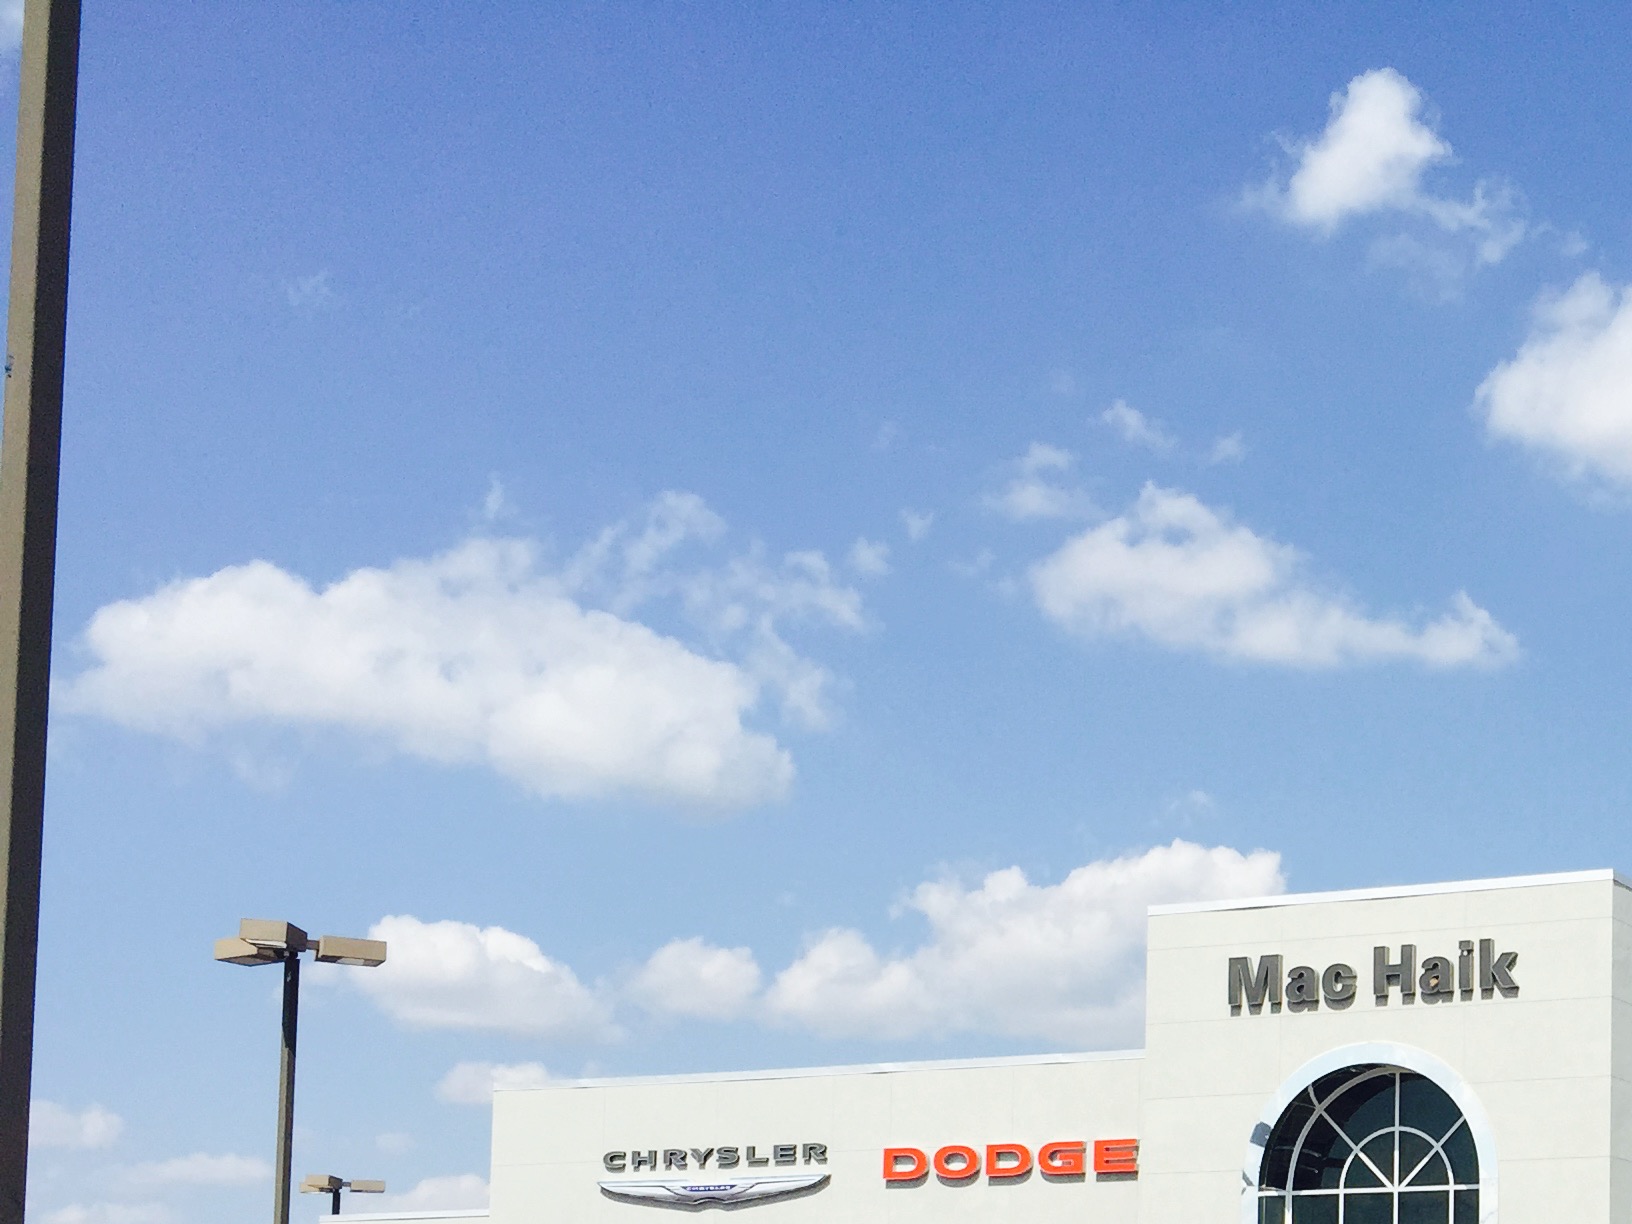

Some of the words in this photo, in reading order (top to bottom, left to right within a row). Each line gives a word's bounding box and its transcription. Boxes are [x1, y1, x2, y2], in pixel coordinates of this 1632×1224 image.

[1228, 953, 1358, 1010] Mac
[1373, 938, 1519, 998] Haik
[603, 1142, 828, 1172] CHRYSLER
[882, 1138, 1139, 1180] DODGE
